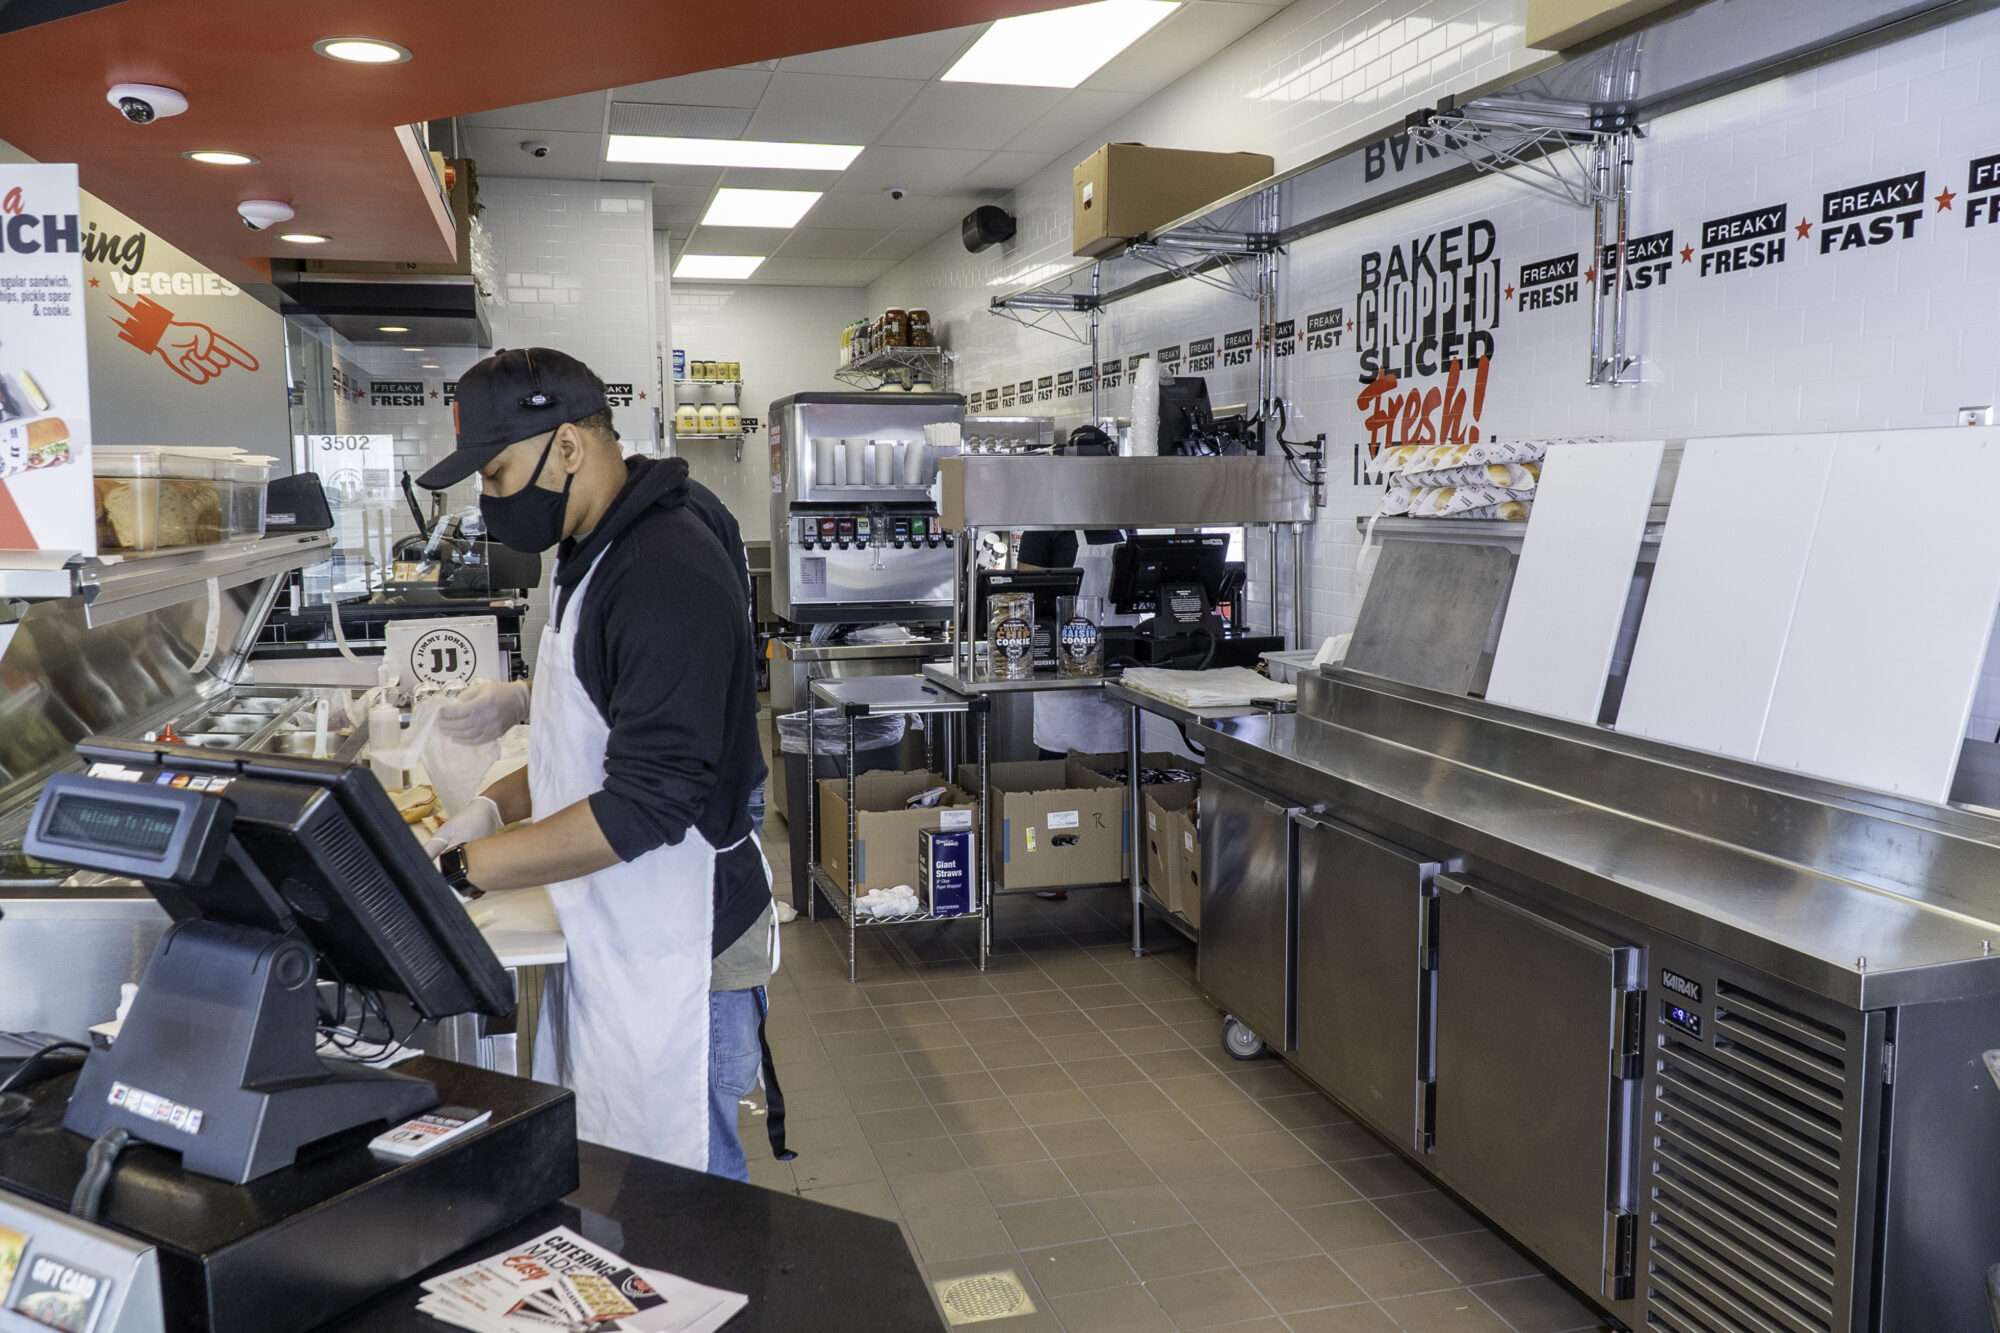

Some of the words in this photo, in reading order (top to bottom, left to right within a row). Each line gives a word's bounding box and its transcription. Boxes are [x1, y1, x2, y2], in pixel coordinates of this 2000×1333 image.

[3, 186, 26, 216] a
[1829, 181, 1918, 217] FREAKY
[1707, 211, 1780, 242] FREAKY
[1820, 209, 1923, 254] FAST
[81, 221, 146, 276] ing
[1361, 219, 1496, 291] BAKED
[1607, 237, 1669, 264] FEAKY
[1700, 238, 1785, 278] FRESH
[1523, 259, 1575, 284] FREAKY
[110, 271, 239, 297] VEGGIES
[1356, 258, 1500, 353] CHOPPED
[1519, 281, 1578, 313] FRESH
[1309, 313, 1341, 329] FREAKY
[1225, 334, 1252, 348] FREAKY
[1307, 330, 1343, 352] FAST
[1189, 356, 1215, 373] FRESH
[1224, 348, 1253, 367] FAST
[1358, 330, 1495, 385] SLICED
[374, 384, 421, 393] FREAKY
[1058, 385, 1073, 398] FAST
[1079, 381, 1093, 394] FRES
[1103, 375, 1121, 390] FAST
[371, 395, 425, 407] FRESH
[1038, 390, 1052, 402] FAST
[1357, 355, 1490, 461] Fresh!
[321, 436, 370, 451] 3502
[417, 635, 441, 657] JIMMY
[444, 634, 470, 655] JOHN'S
[997, 631, 1031, 639] CHIP
[997, 638, 1031, 646] COOKIE
[1062, 629, 1097, 638] RAISIN
[430, 648, 458, 674] JJ
[936, 860, 956, 869] Giant
[936, 869, 963, 878] Straws
[1663, 971, 1699, 1000] KAIRAK
[523, 1244, 583, 1276] MADE
[544, 1236, 617, 1278] CATERING
